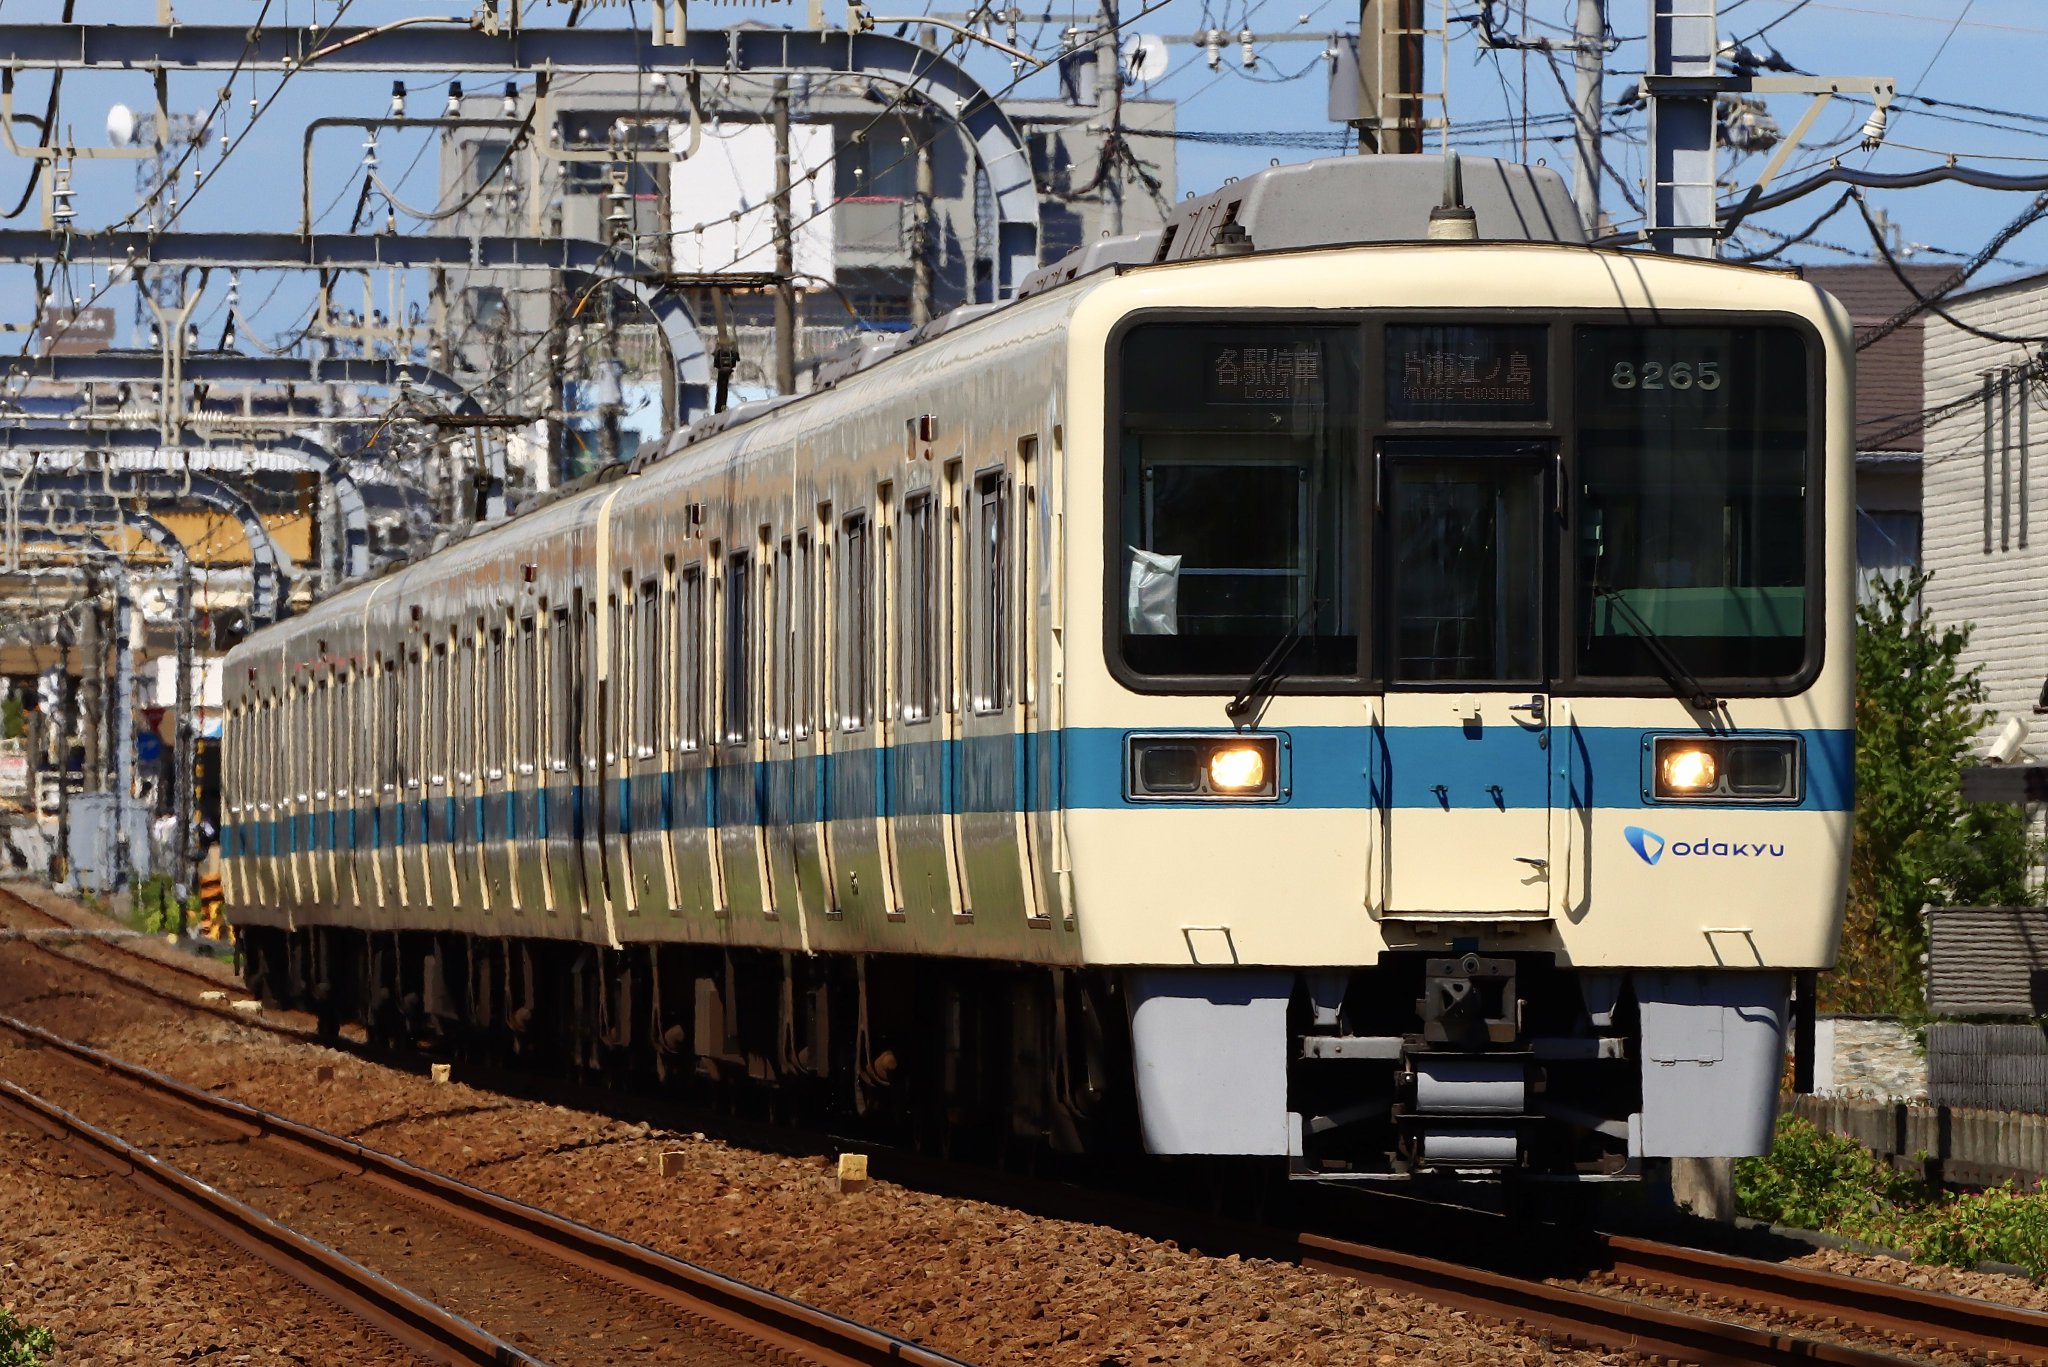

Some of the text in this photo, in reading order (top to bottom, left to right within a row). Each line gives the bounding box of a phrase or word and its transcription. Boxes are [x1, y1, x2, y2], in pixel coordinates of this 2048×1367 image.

[1215, 348, 1319, 385] 各駅停車
[1402, 351, 1532, 385] 片瀬江ノ島
[1611, 361, 1721, 390] 8265
[1244, 387, 1290, 400] Local
[1671, 837, 1785, 857] odakyu
